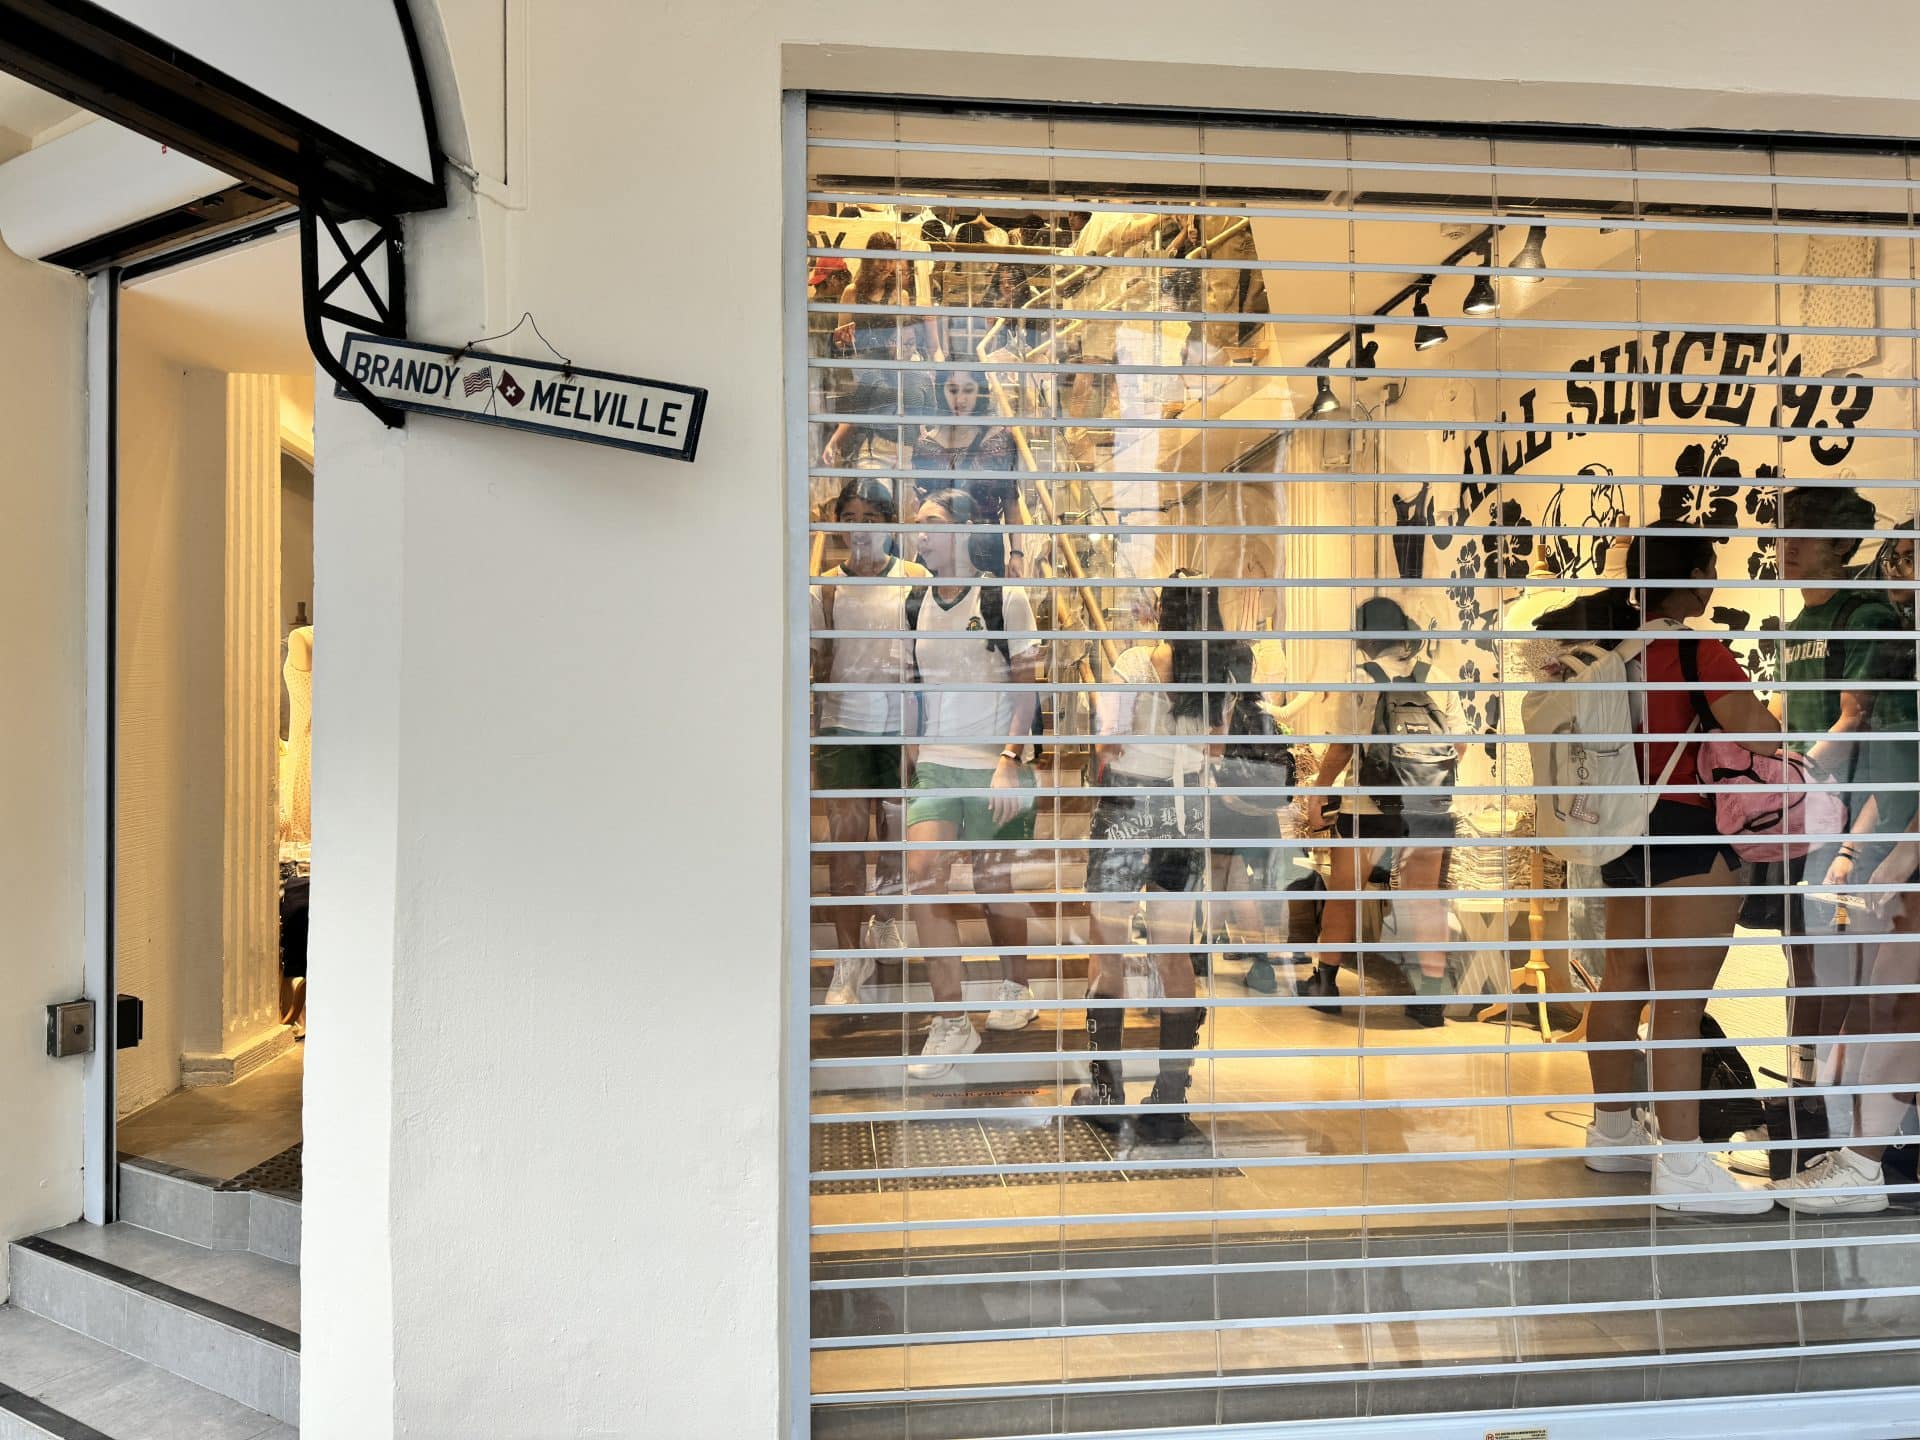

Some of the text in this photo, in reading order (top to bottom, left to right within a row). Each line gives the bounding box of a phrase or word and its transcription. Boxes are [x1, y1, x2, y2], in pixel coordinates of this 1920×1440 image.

[351, 351, 682, 437] BRANDY MELVILLE
[1566, 331, 1766, 440] SINCE
